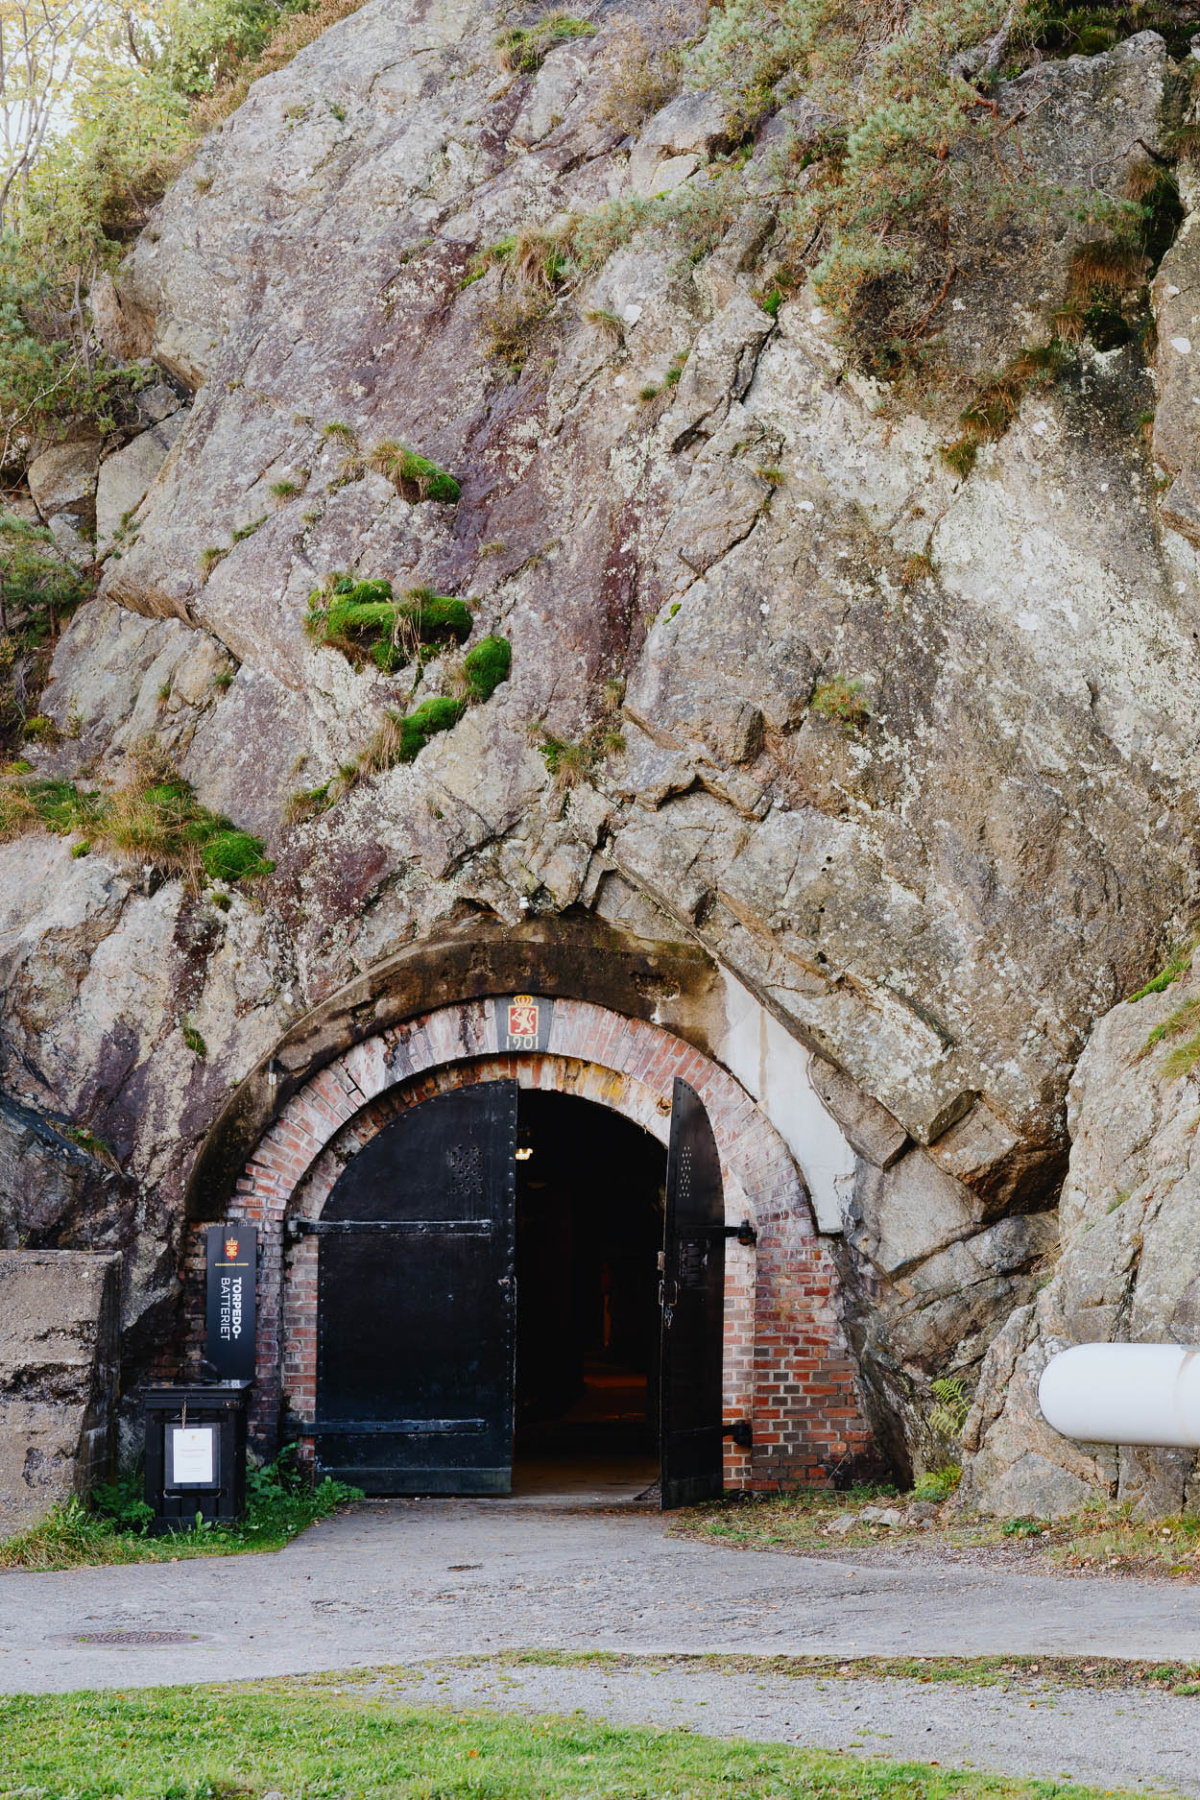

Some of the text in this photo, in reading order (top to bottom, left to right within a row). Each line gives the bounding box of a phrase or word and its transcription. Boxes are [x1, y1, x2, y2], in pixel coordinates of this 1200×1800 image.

[506, 1036, 539, 1050] 1901
[220, 1277, 231, 1341] BATTERIET
[232, 1276, 242, 1339] TORPEDO-
